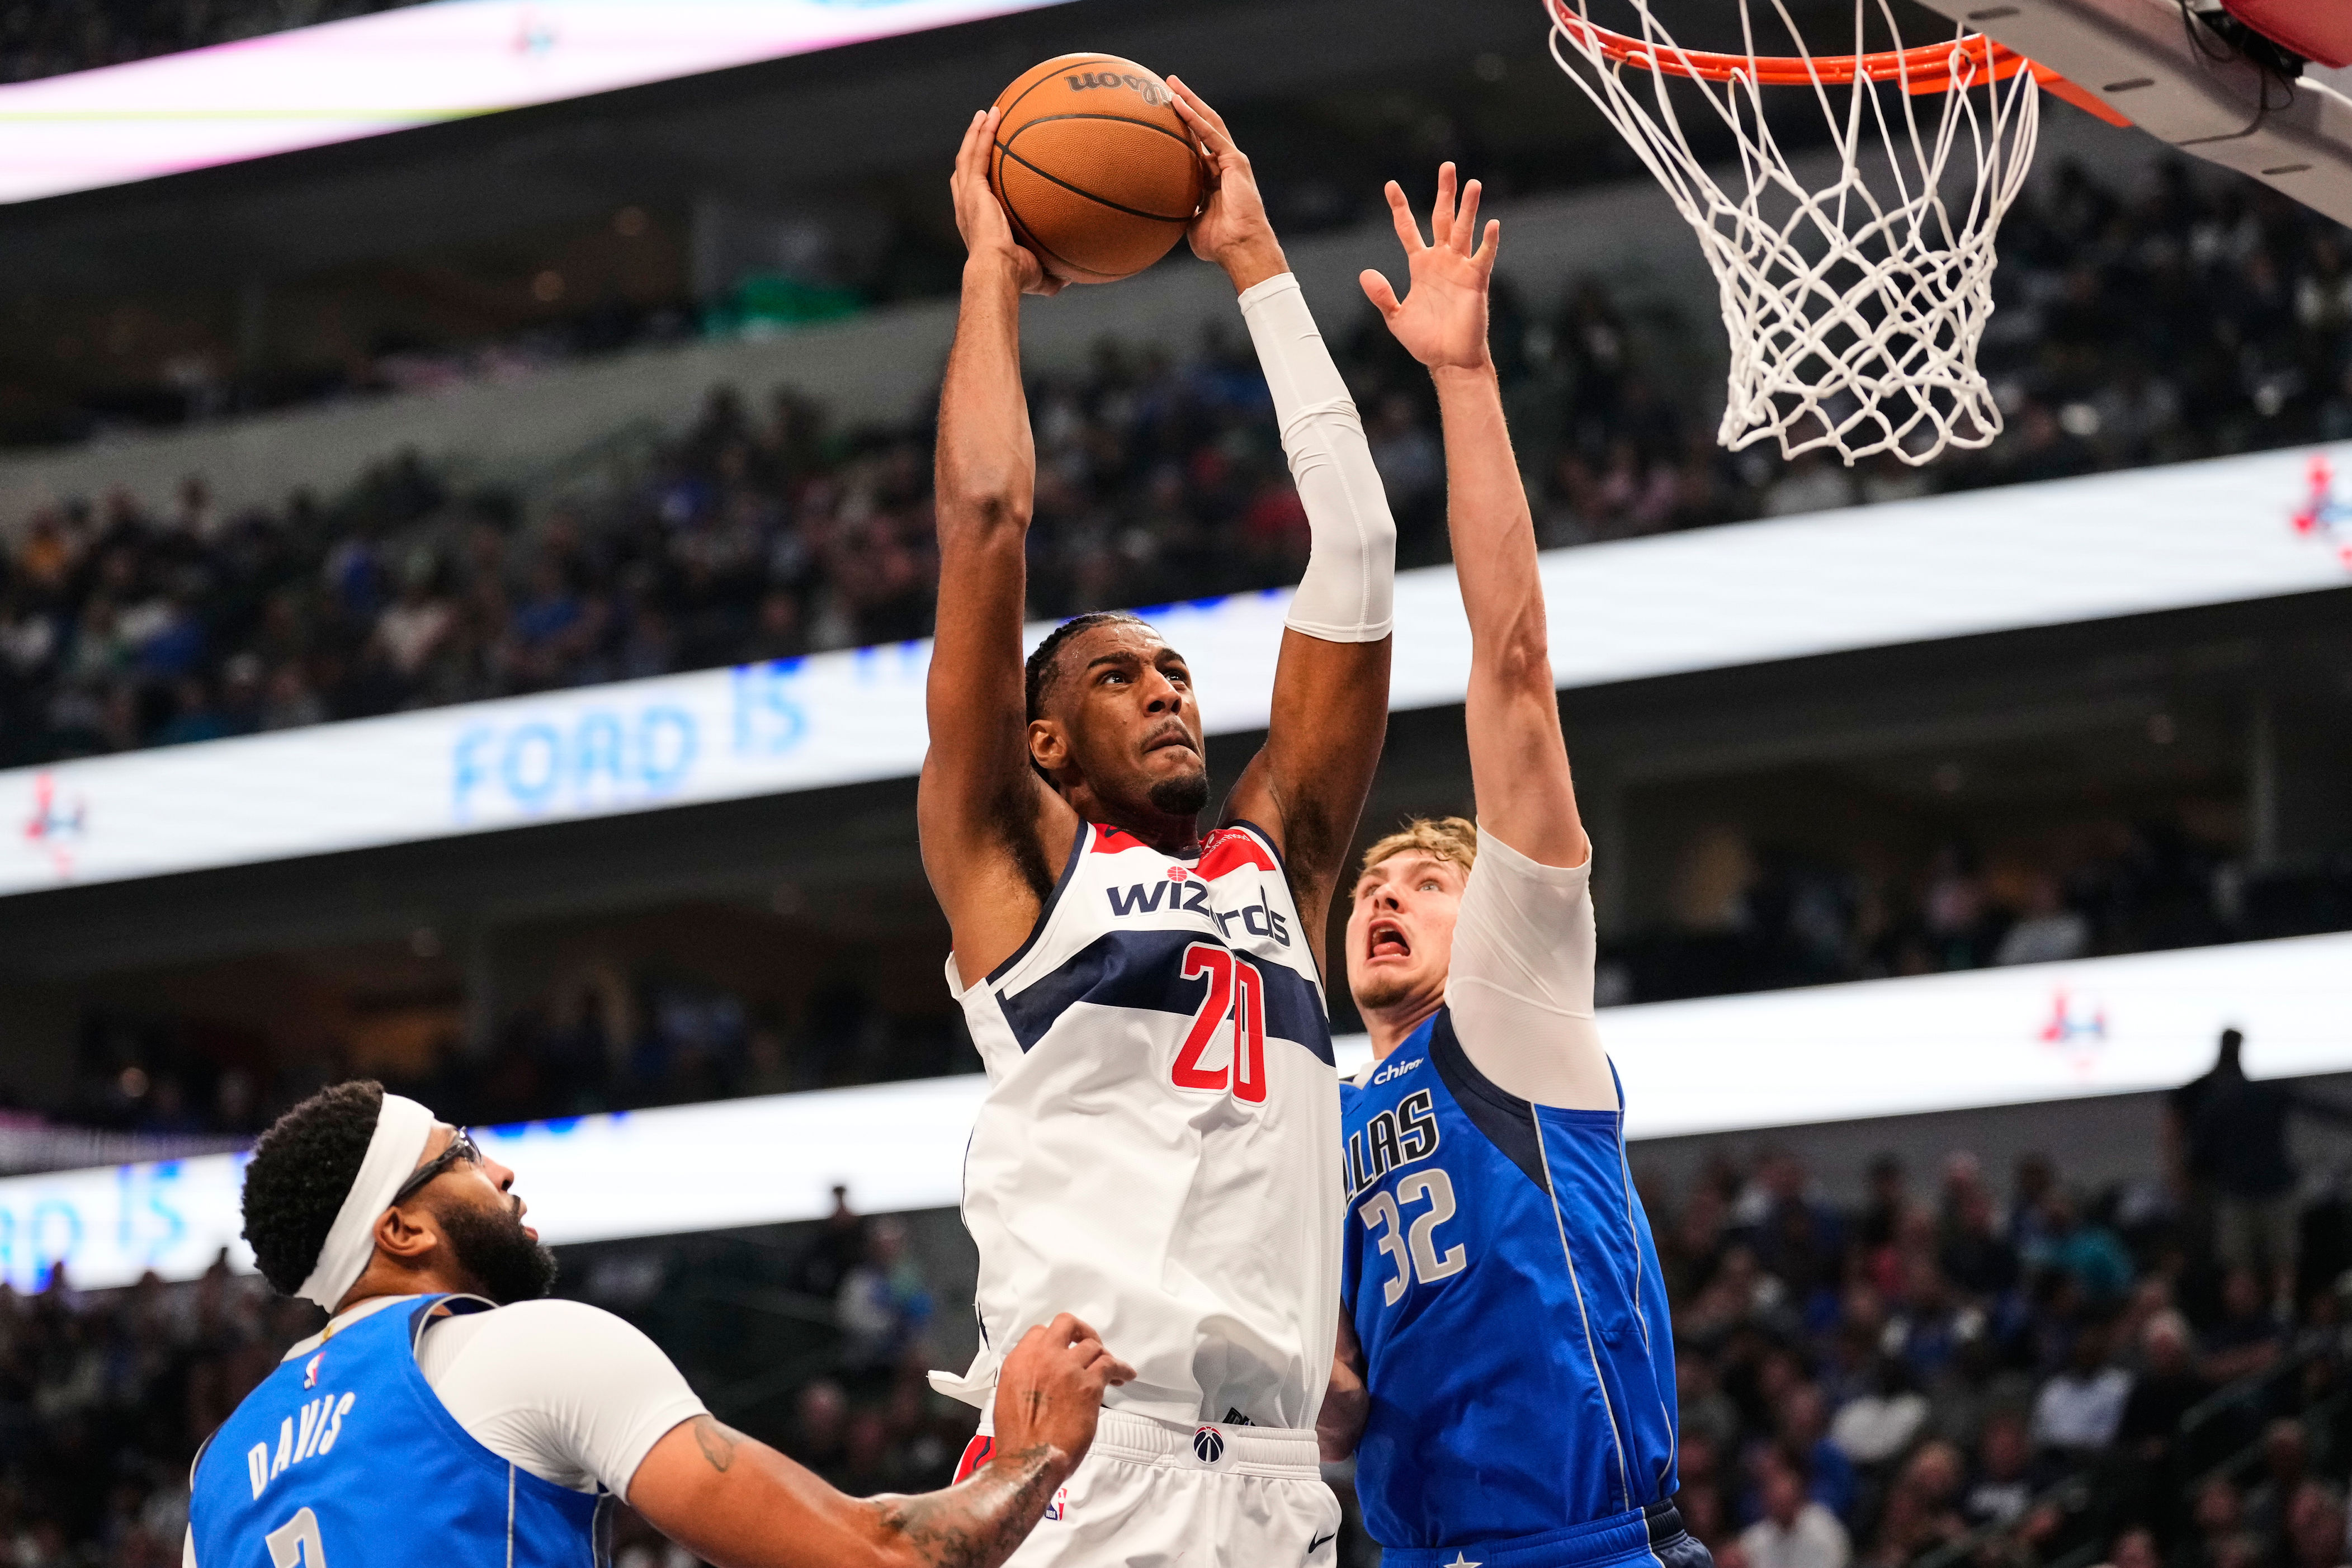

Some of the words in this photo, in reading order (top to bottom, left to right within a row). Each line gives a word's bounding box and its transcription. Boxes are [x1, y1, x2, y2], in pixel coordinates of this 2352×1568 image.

[1065, 71, 1175, 110] ilson
[1106, 880, 1290, 947] wizrds
[1171, 941, 1267, 1107] 20
[1358, 1168, 1467, 1307] 32
[248, 1392, 355, 1500] DAVIS
[1046, 1510, 1056, 1519] NBA
